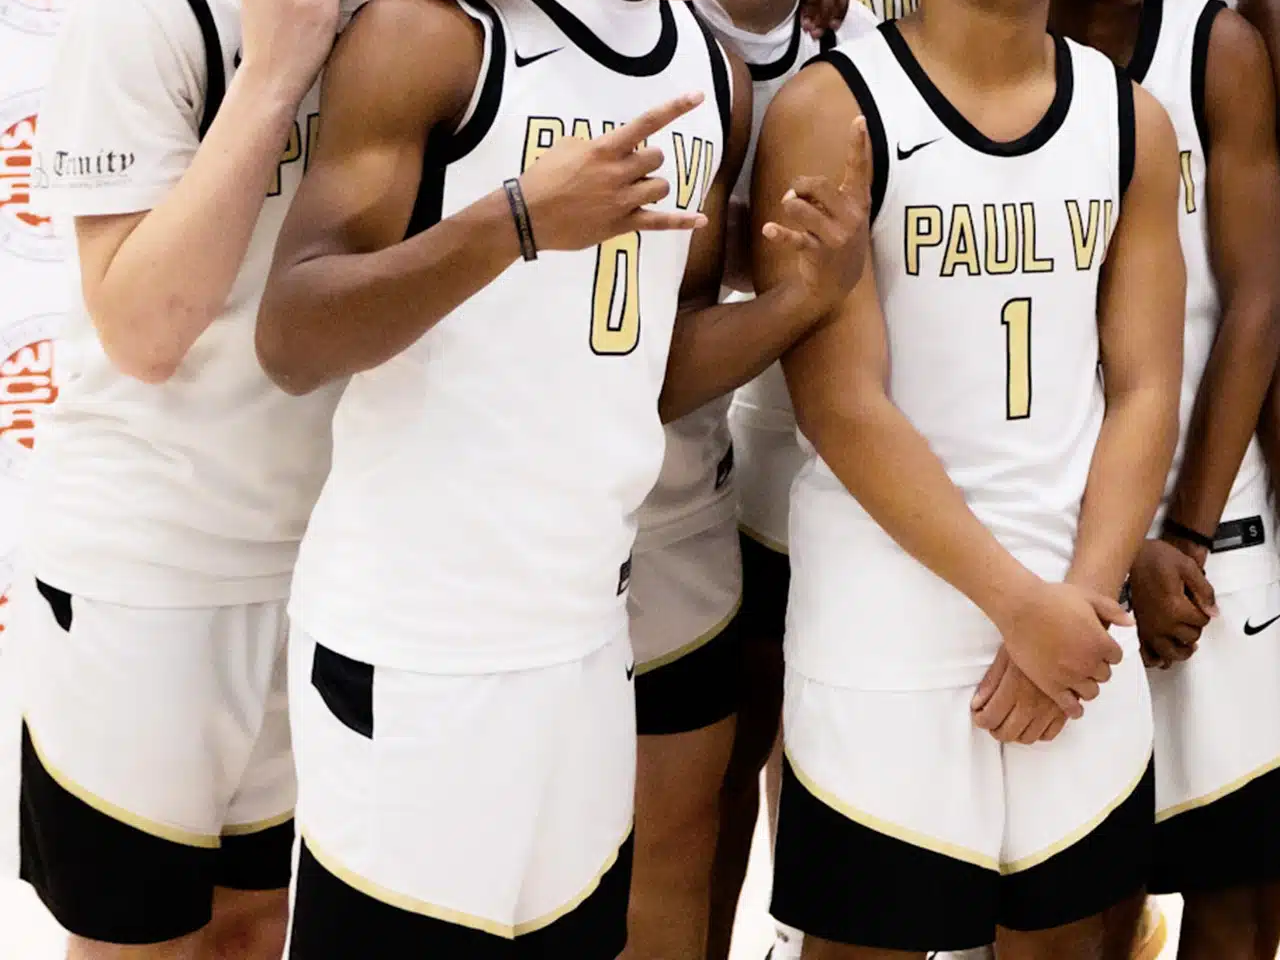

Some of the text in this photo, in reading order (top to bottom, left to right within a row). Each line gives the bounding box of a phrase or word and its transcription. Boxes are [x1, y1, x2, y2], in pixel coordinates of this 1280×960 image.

[589, 230, 641, 356] 0
[904, 201, 1055, 277] PAUL
[1001, 296, 1033, 420] 1
